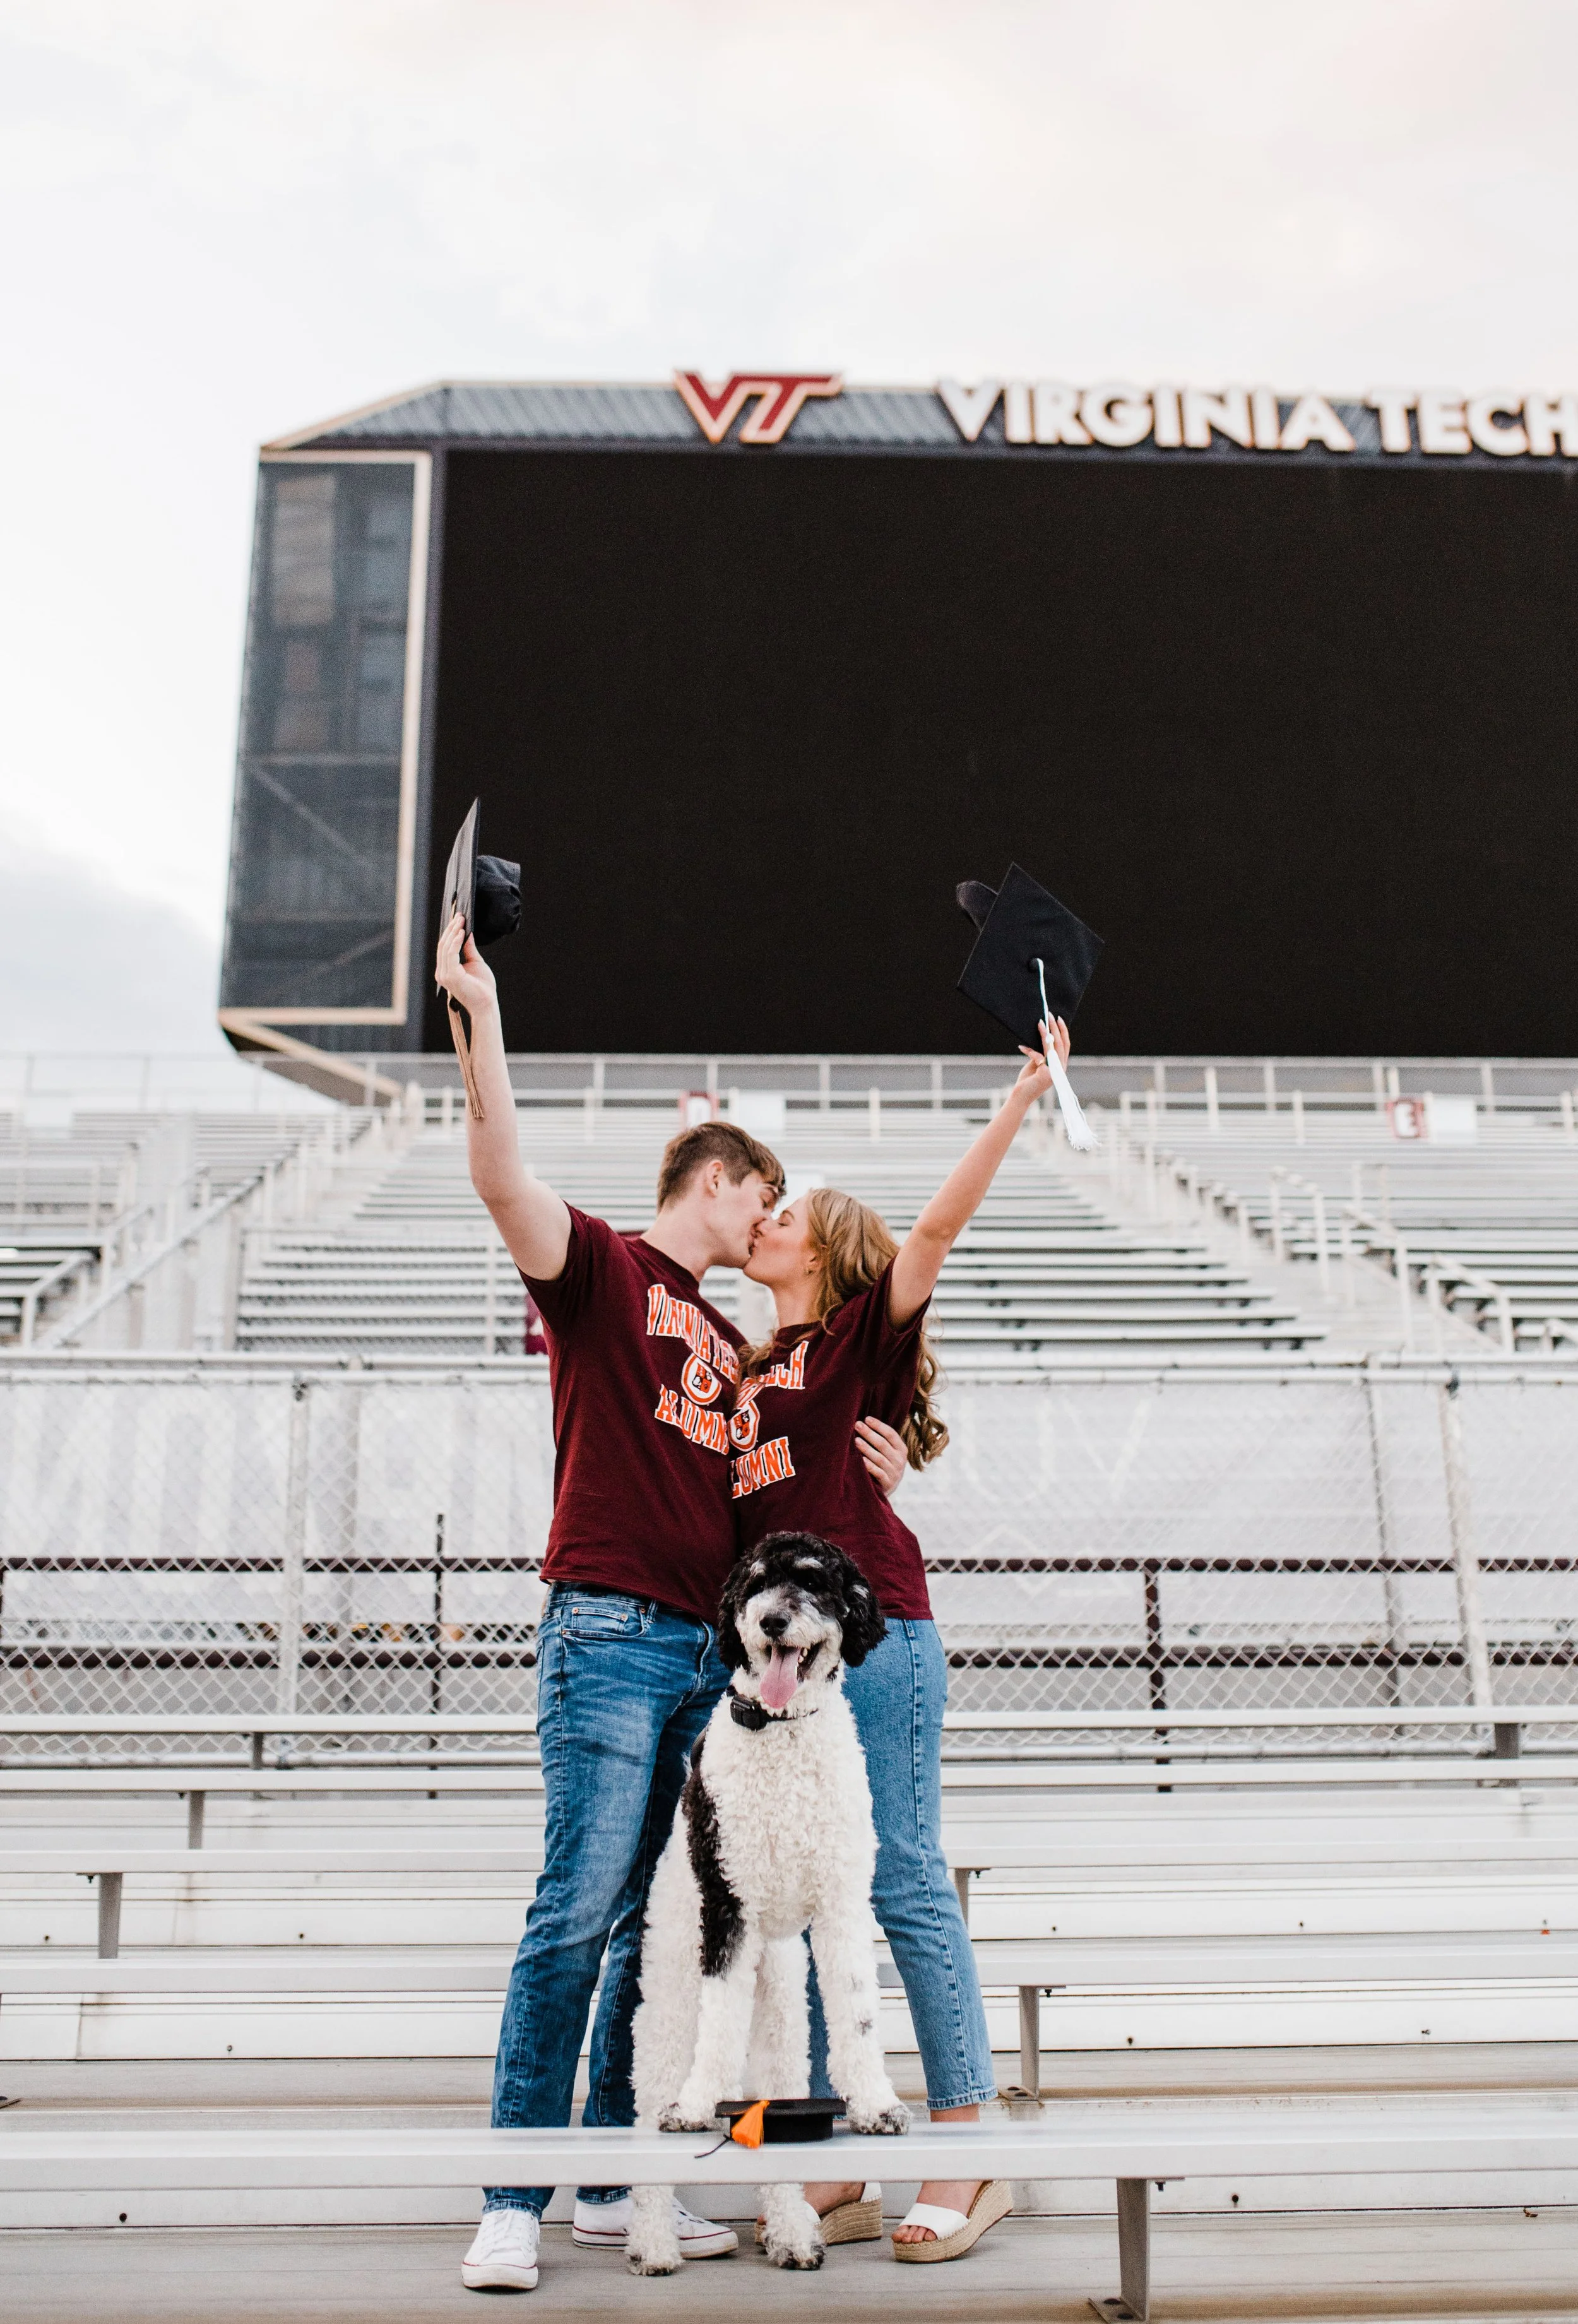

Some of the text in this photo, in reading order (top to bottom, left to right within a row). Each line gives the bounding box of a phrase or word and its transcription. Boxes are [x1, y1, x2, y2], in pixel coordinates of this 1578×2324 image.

[675, 369, 843, 443] VT
[938, 380, 1578, 456] VIRGINIA TECH
[729, 1436, 796, 1498] LUMNI
